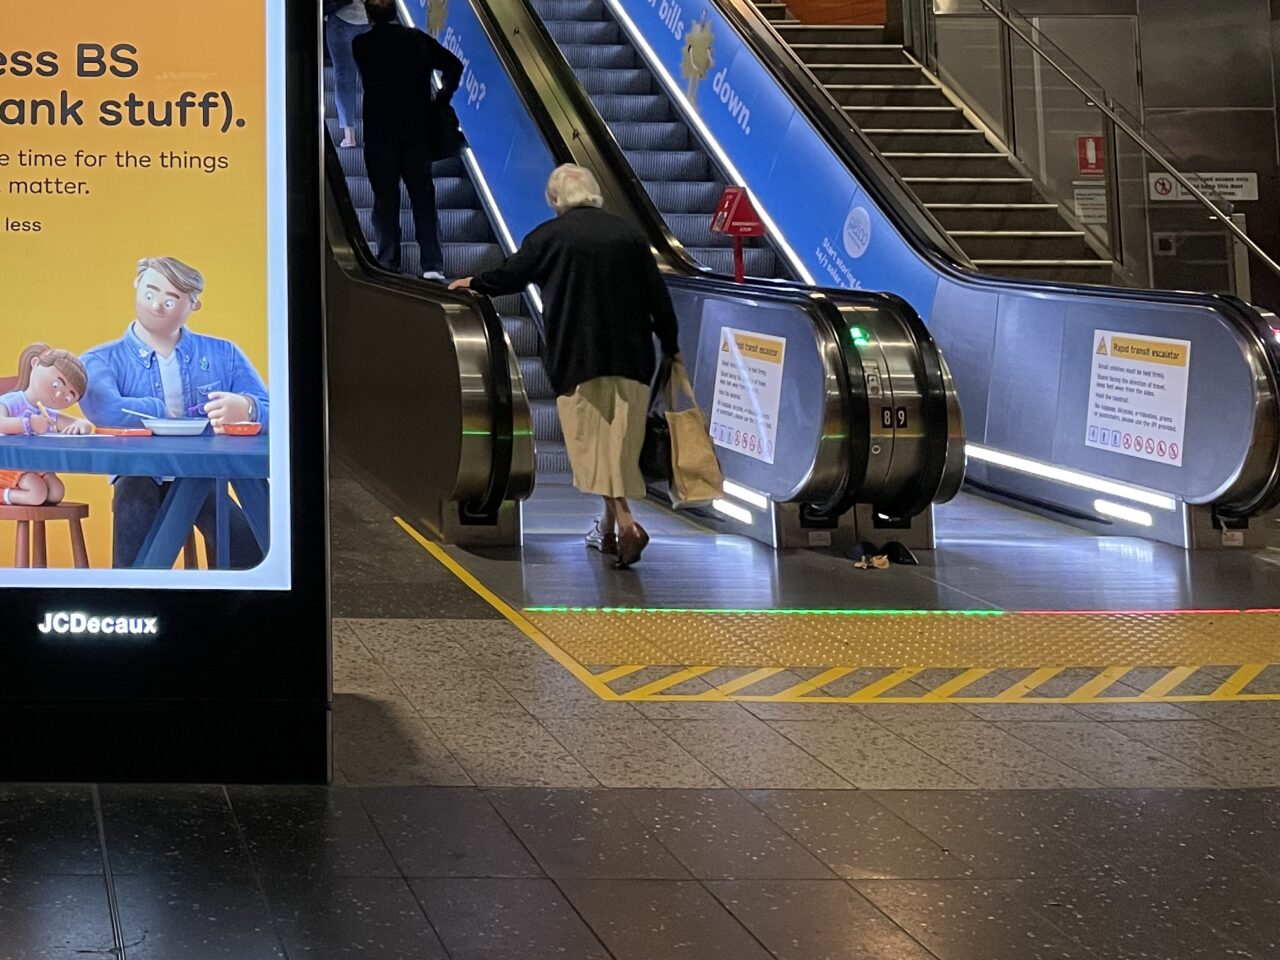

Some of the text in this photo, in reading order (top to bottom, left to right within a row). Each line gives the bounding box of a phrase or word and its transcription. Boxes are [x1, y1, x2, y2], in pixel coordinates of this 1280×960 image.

[76, 43, 140, 78] BS
[99, 90, 246, 133] stuff).
[712, 67, 751, 136] down.
[17, 149, 67, 168] time
[75, 150, 108, 168] for
[115, 150, 152, 169] the
[159, 151, 229, 173] things
[8, 178, 91, 196] matter.
[5, 217, 42, 232] less
[1113, 342, 1180, 360] Rapid transit escalator
[884, 410, 905, 425] 8 9
[38, 612, 158, 634] JCDecaux
